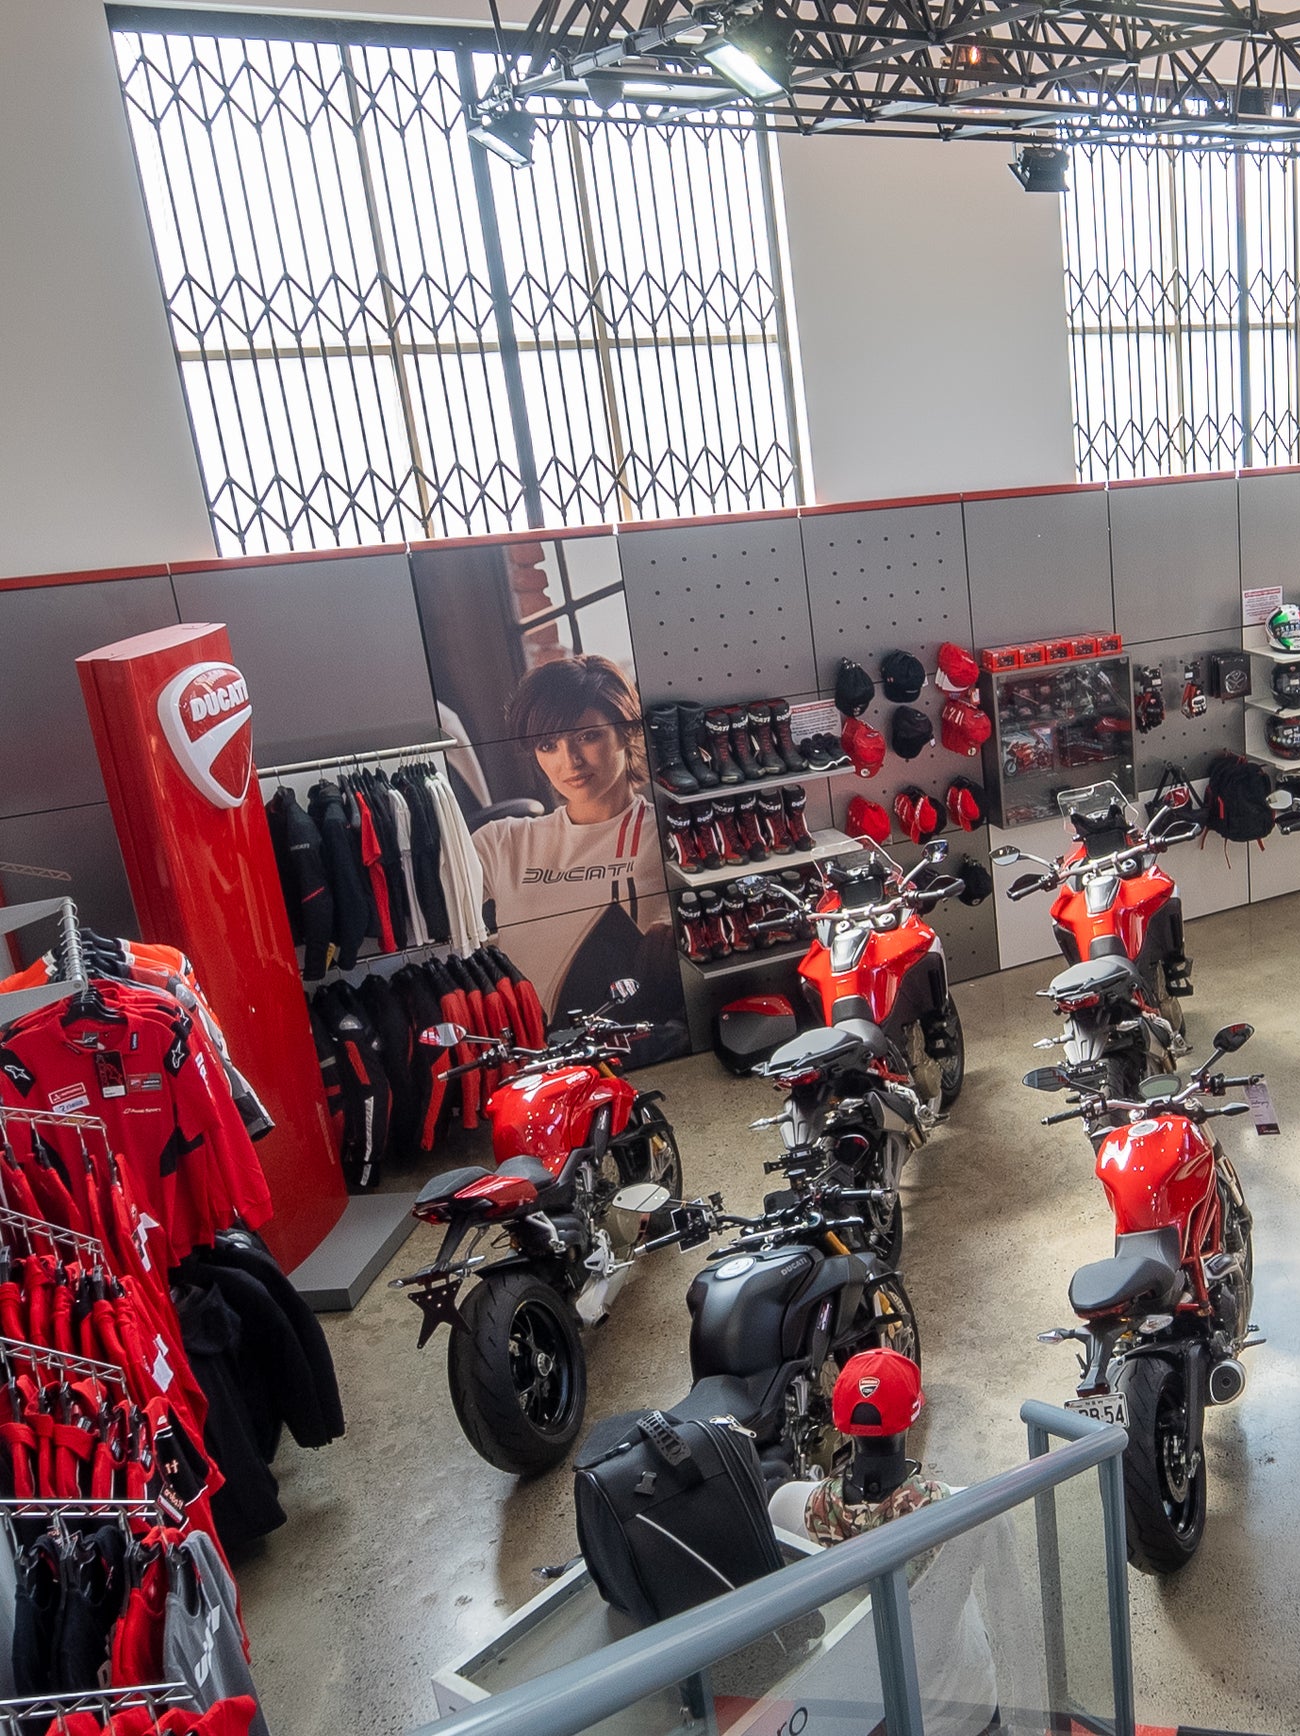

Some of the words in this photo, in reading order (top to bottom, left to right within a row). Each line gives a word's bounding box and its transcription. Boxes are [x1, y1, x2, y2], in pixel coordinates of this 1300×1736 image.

[189, 678, 249, 722] DUCATI
[522, 861, 634, 884] DUCATI
[780, 1257, 808, 1276] DUCATI
